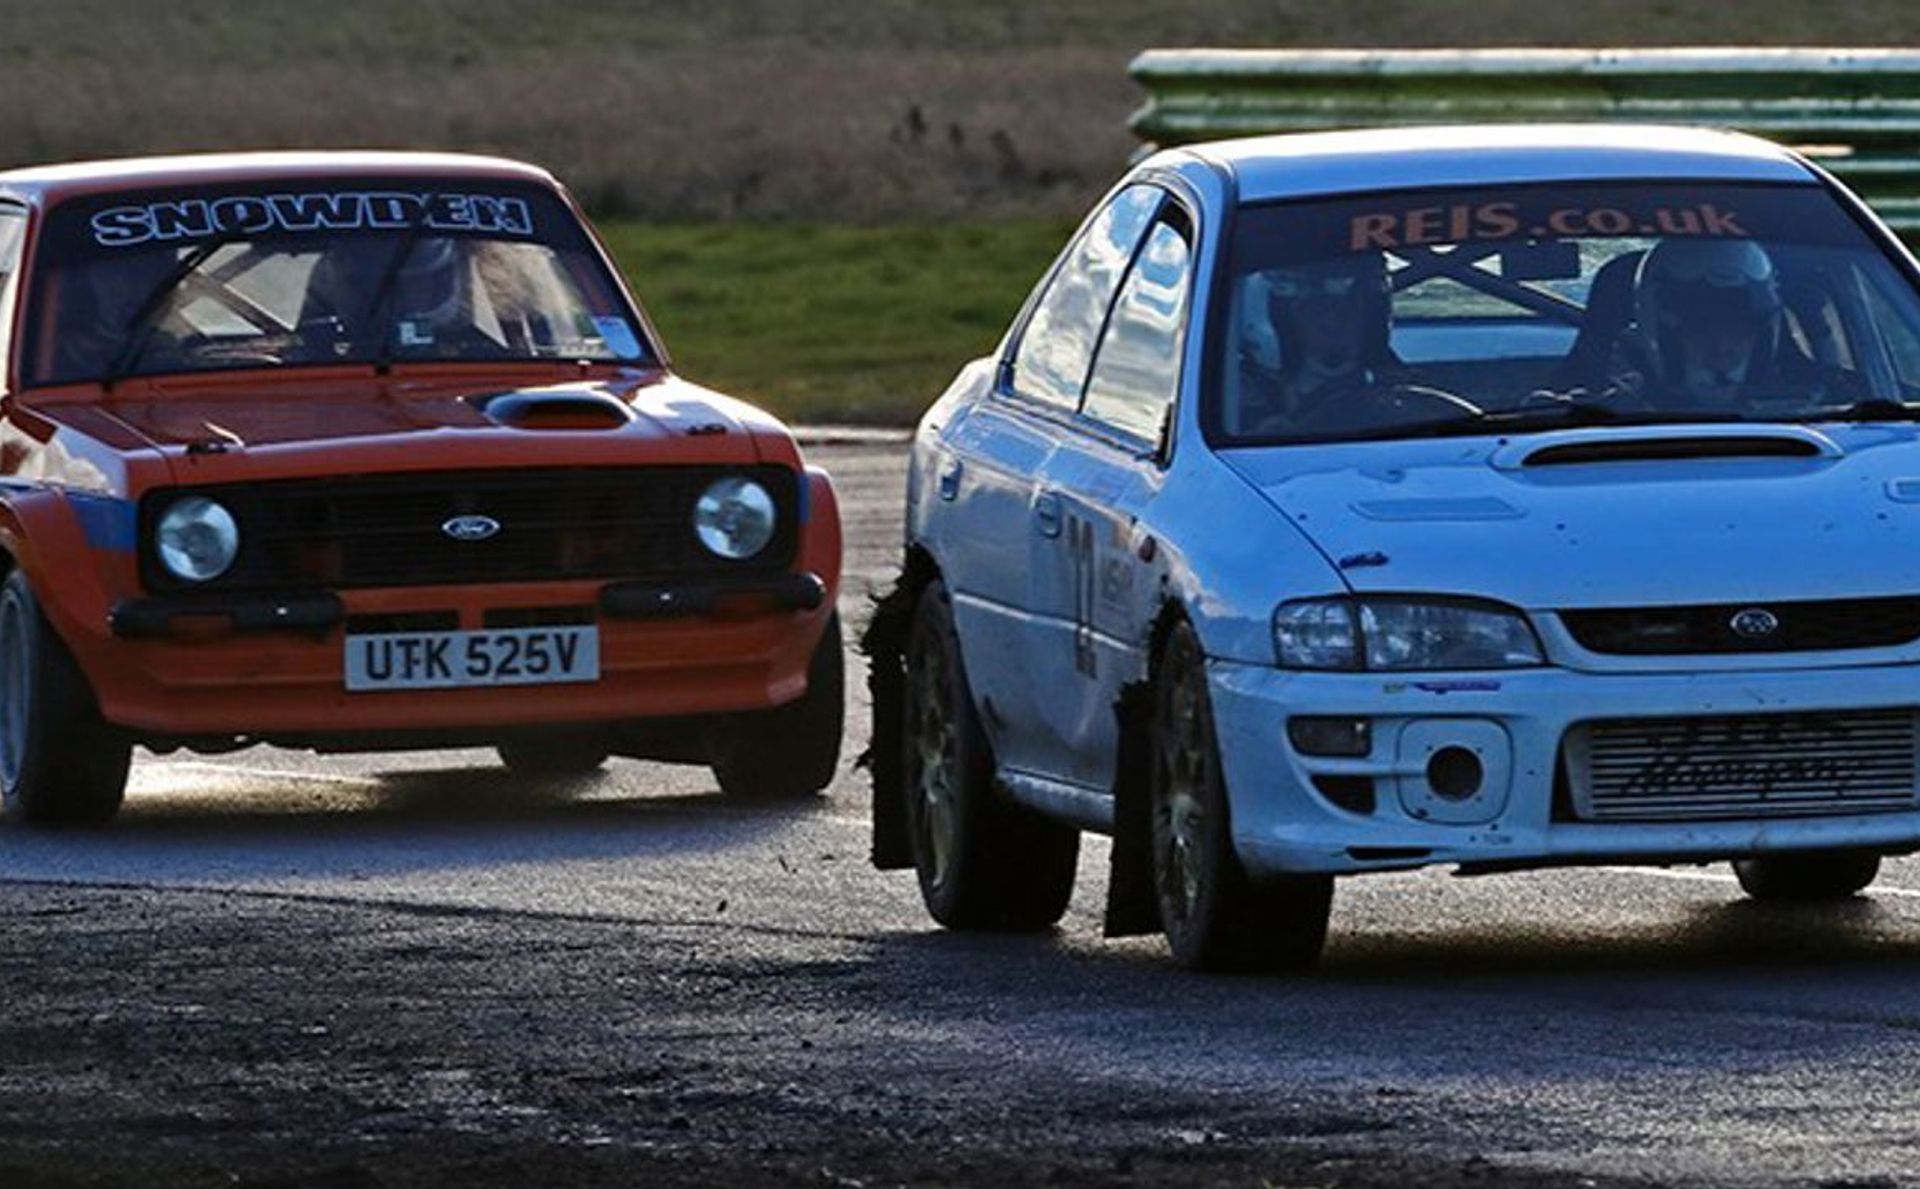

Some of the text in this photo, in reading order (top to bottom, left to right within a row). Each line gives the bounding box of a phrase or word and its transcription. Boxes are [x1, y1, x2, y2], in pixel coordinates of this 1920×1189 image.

[91, 192, 533, 246] SNOWDEN
[1349, 201, 1750, 251] REIS.co.uk
[364, 632, 579, 681] UTK 525V
